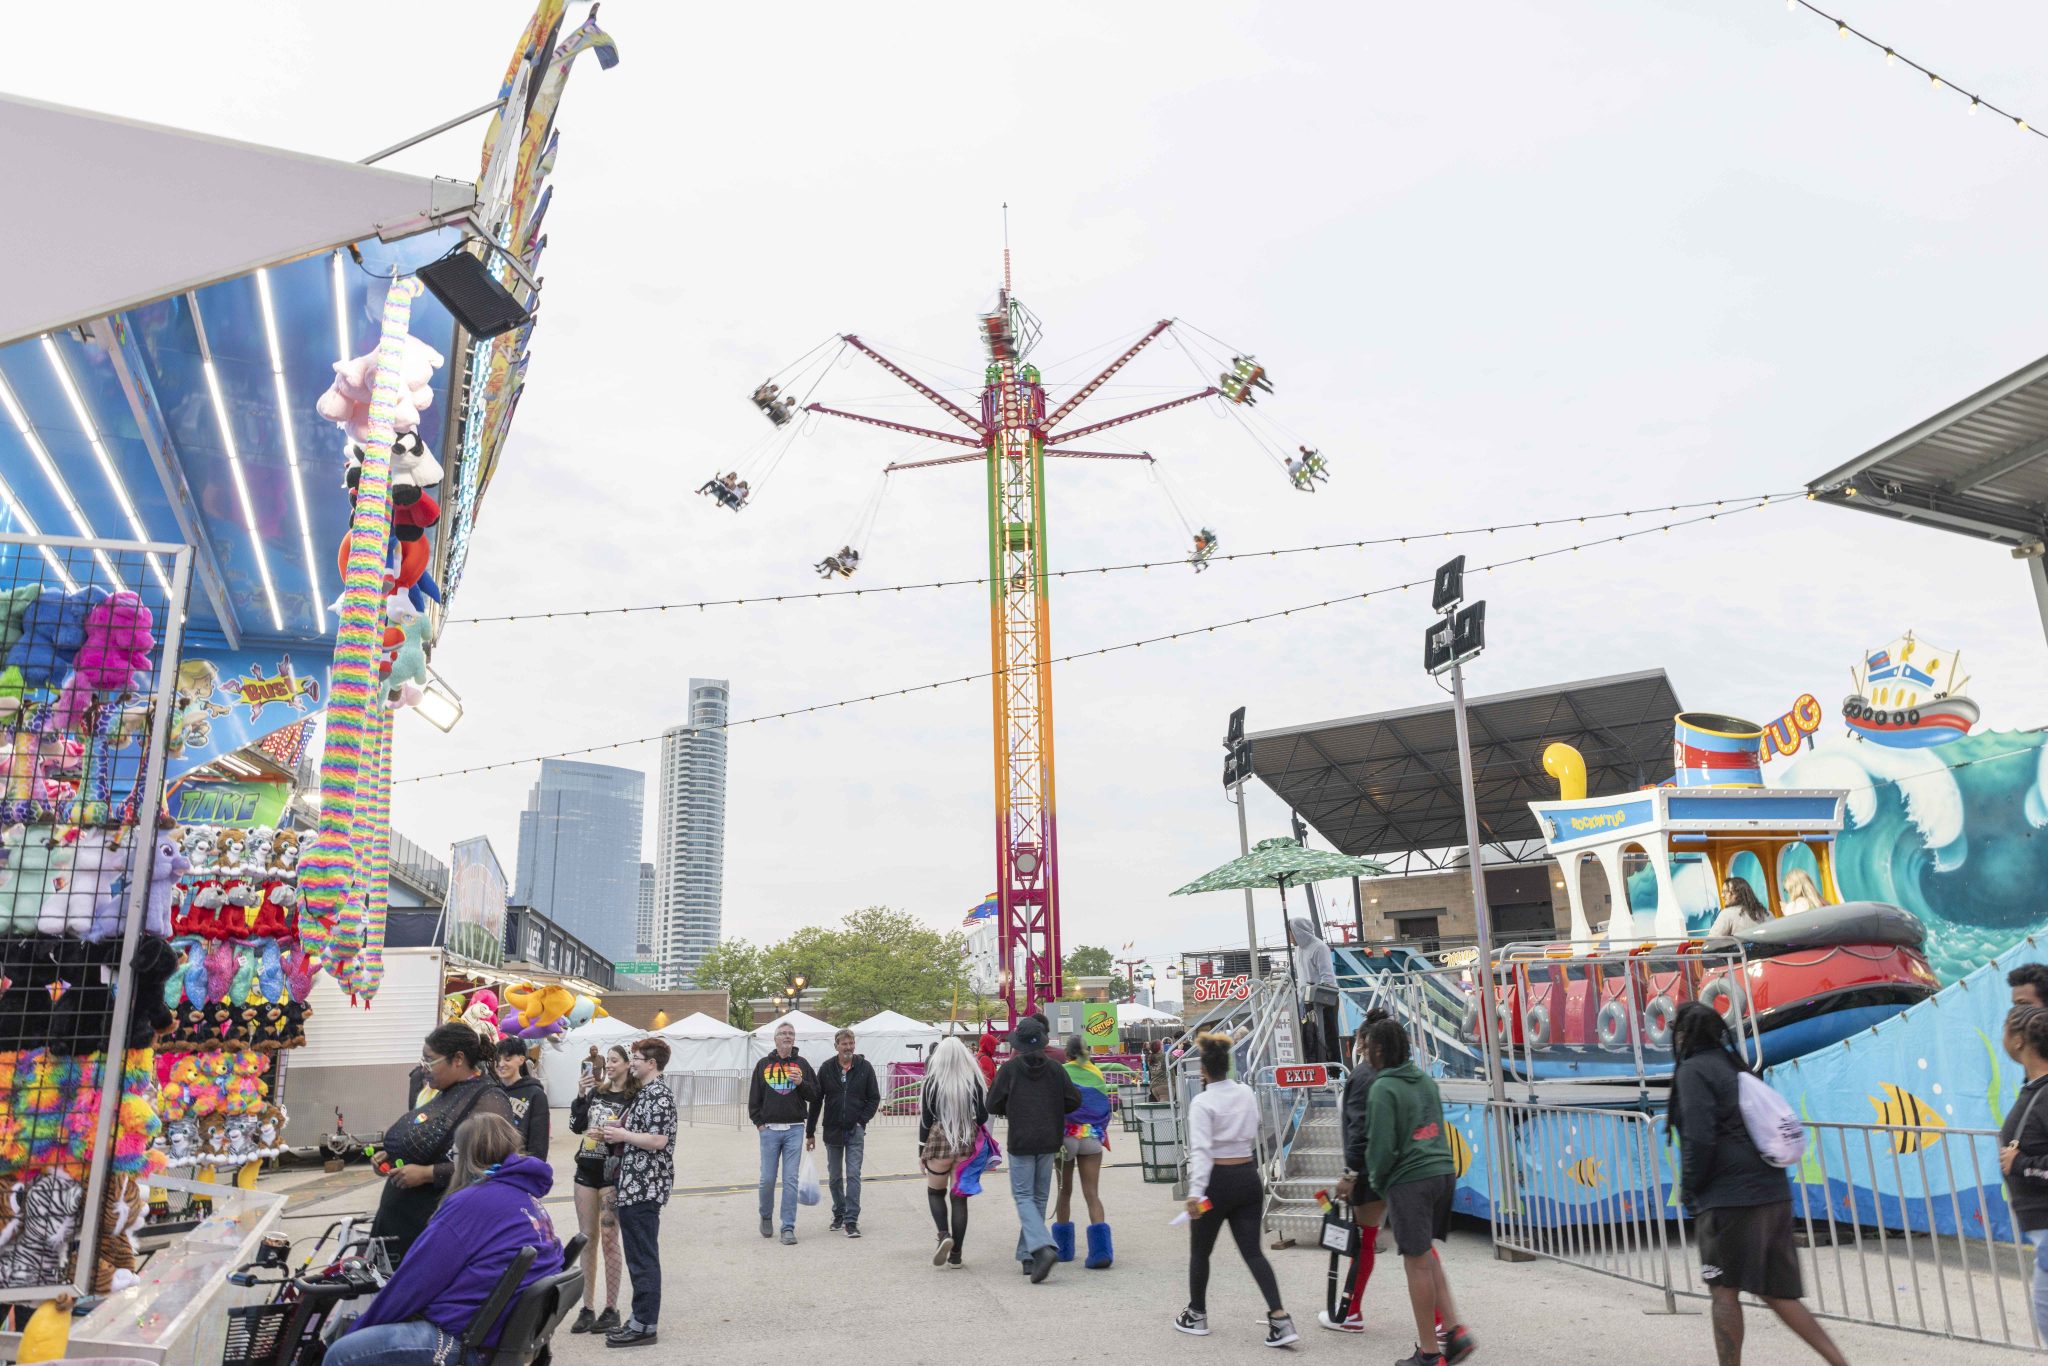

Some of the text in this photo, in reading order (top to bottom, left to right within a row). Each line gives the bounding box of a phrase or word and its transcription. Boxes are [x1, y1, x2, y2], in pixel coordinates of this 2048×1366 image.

[1760, 694, 1821, 763] TUG
[177, 791, 260, 822] TAKE
[1088, 1017, 1115, 1034] VERTIGO
[1285, 1069, 1315, 1083] EXIT
